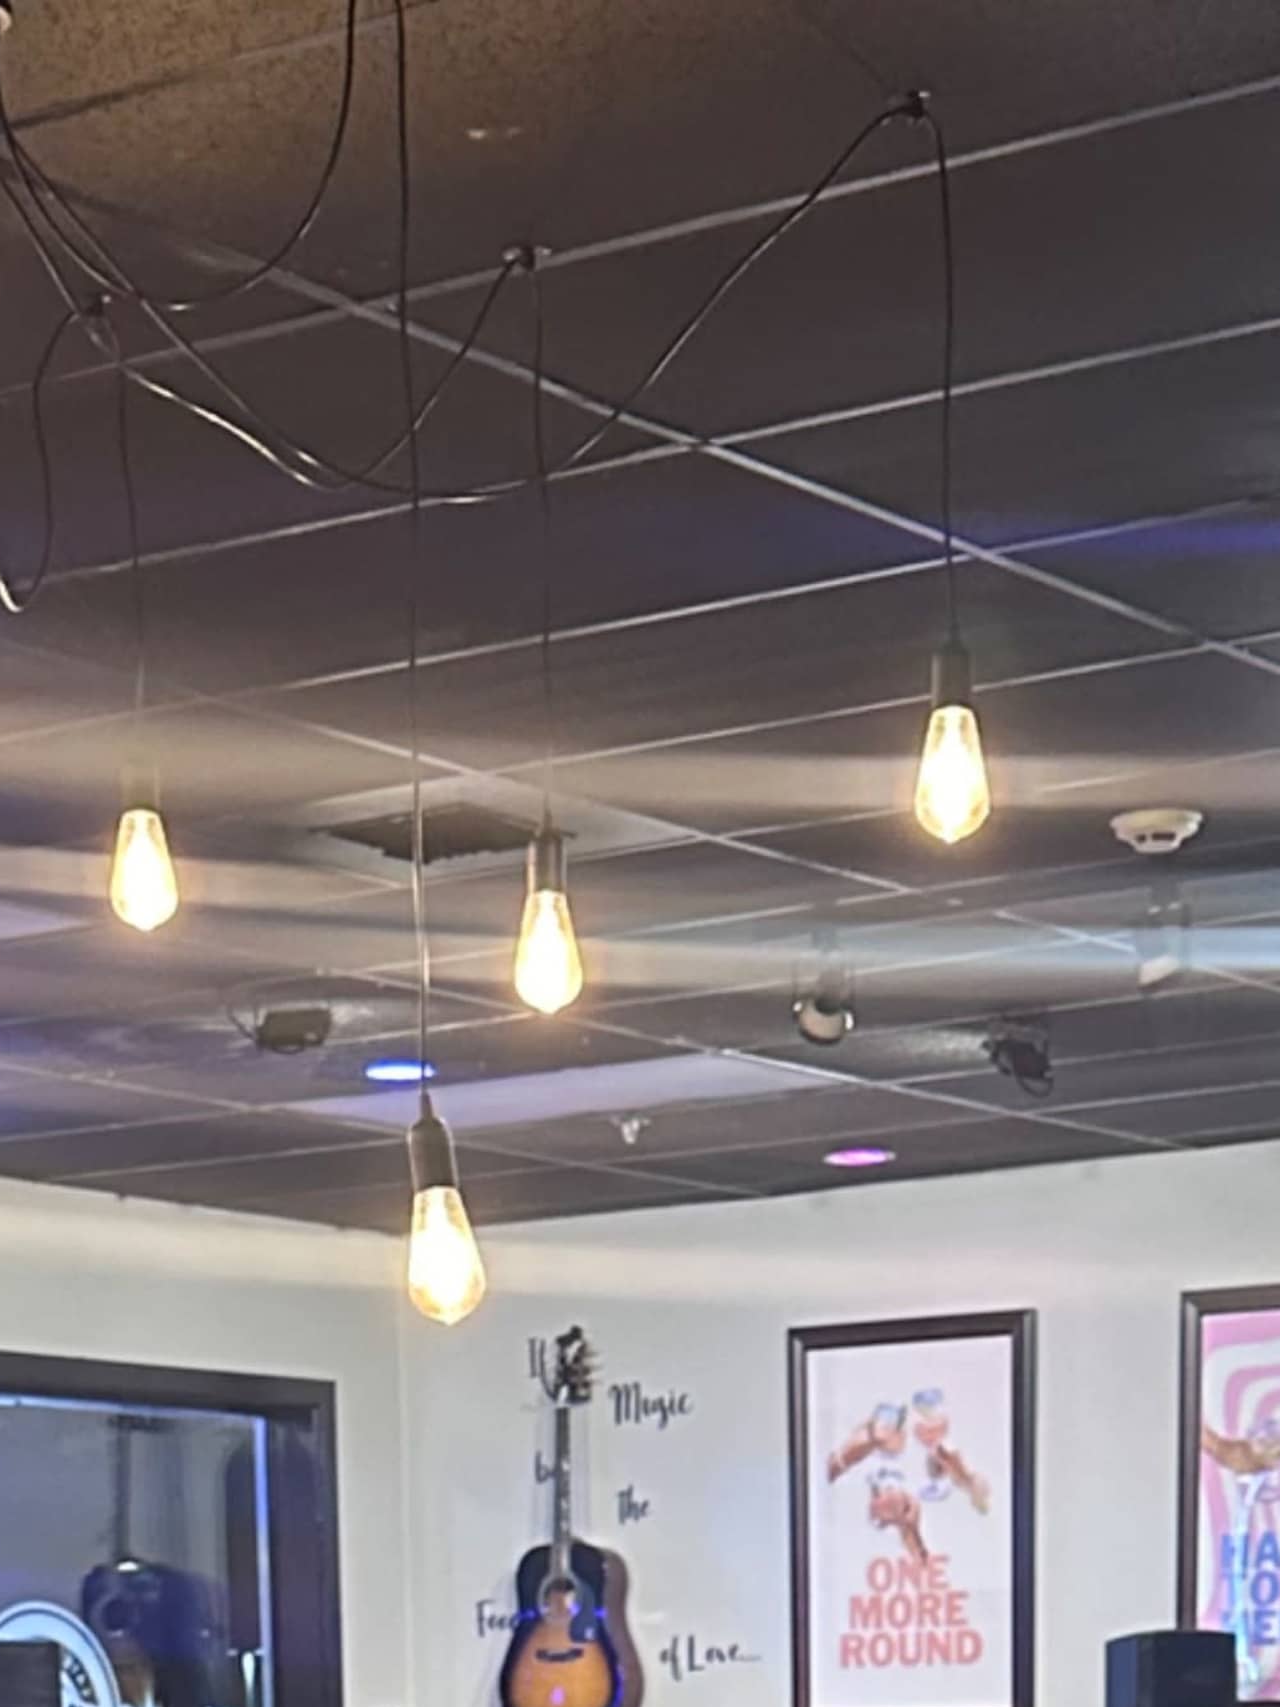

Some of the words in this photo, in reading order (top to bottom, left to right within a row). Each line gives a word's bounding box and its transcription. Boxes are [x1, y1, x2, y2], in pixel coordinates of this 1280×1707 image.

[866, 1554, 951, 1593] ONE
[476, 1599, 518, 1639] Foo
[848, 1590, 971, 1630] MORE
[839, 1628, 985, 1669] ROUND
